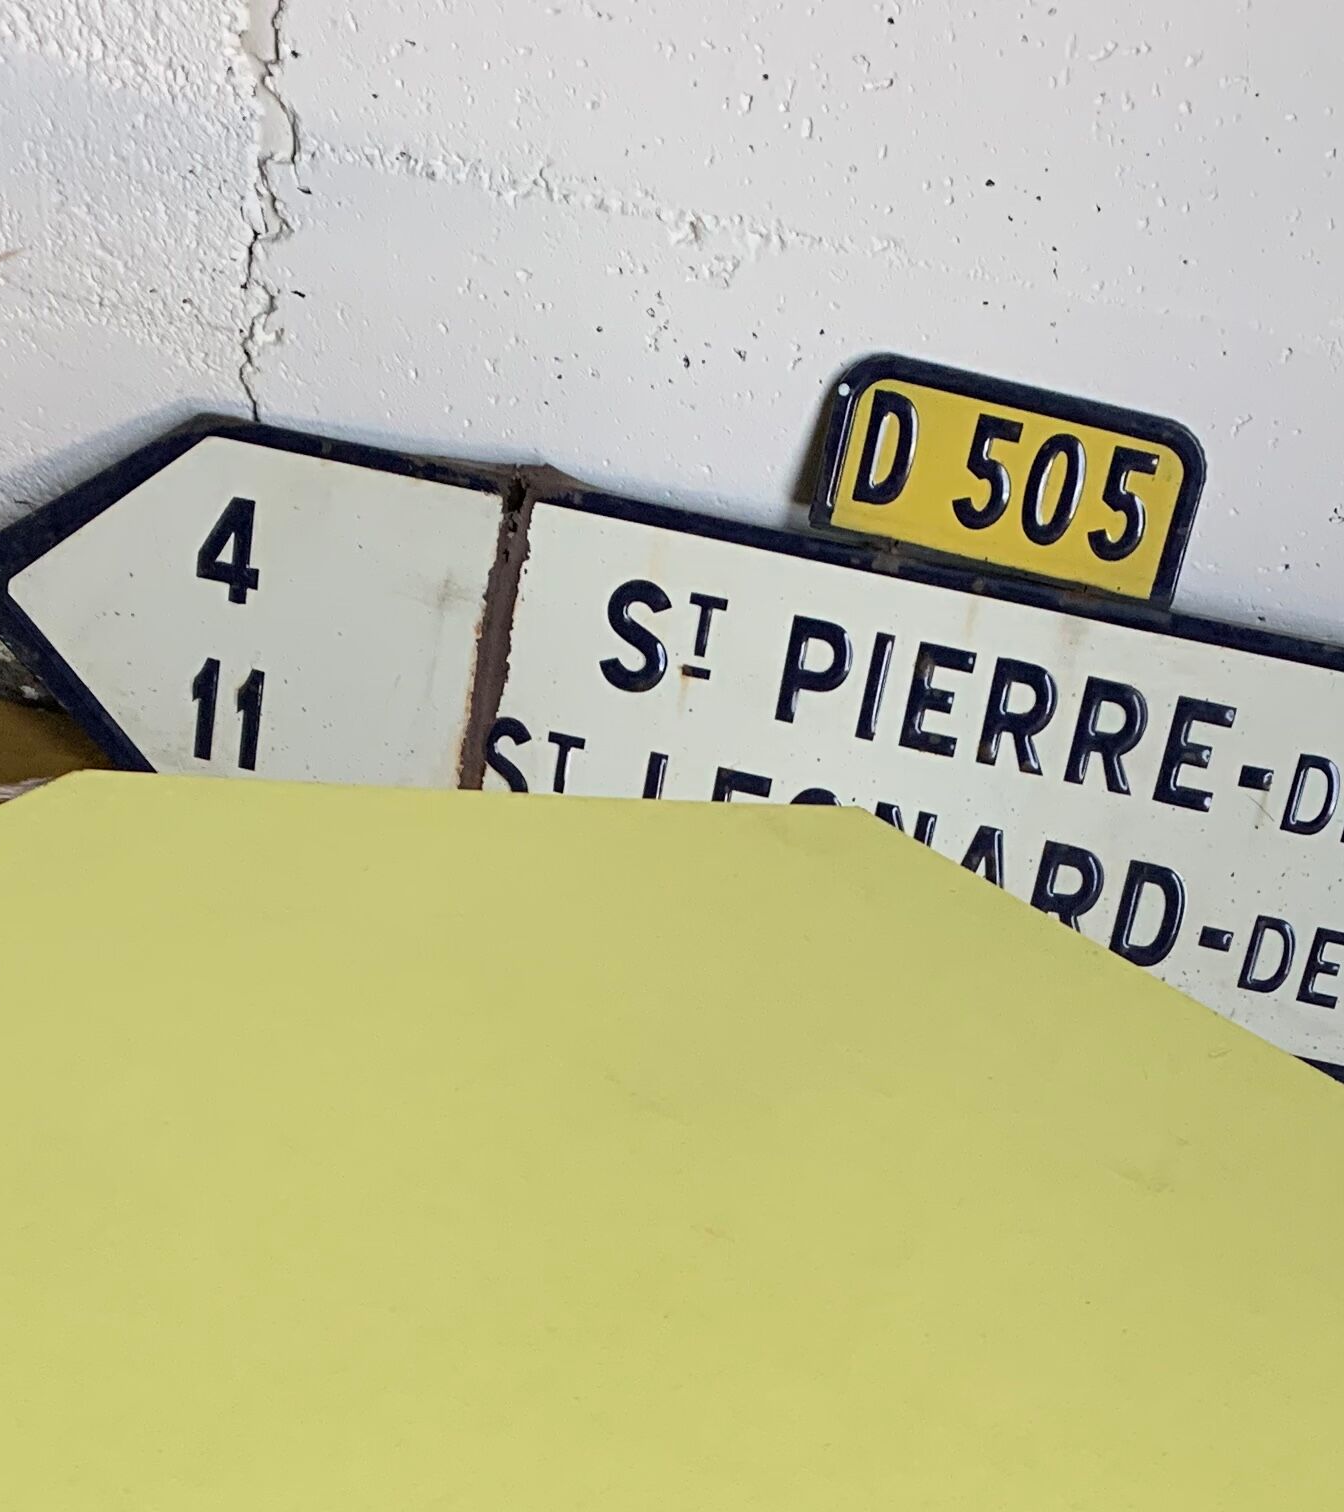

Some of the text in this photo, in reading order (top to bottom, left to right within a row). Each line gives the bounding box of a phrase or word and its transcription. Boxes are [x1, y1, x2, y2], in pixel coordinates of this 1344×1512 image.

[852, 389, 1160, 562] D 505
[196, 496, 260, 605] 4
[192, 657, 266, 771] 11
